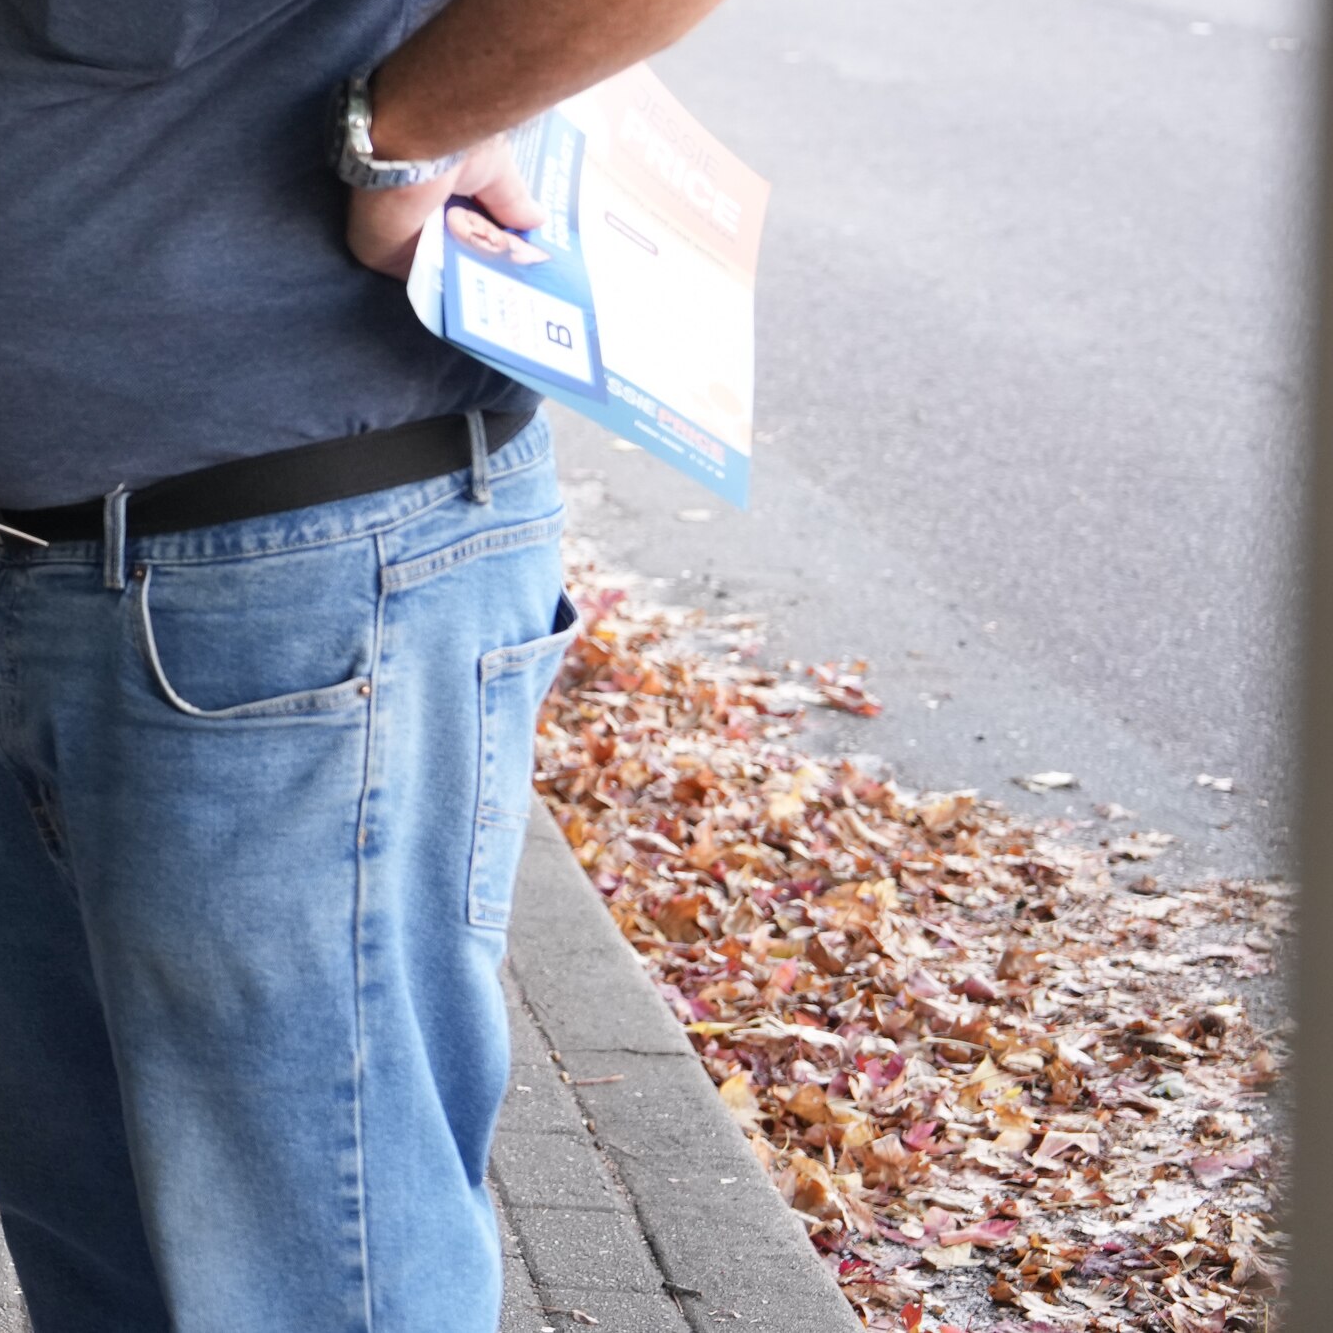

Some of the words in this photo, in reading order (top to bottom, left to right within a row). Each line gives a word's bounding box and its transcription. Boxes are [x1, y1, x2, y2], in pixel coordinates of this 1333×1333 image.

[621, 106, 742, 234] PRICE
[636, 85, 720, 179] JESSIE
[546, 321, 572, 349] B
[604, 373, 658, 419] SSIE
[658, 407, 725, 463] PRICE
